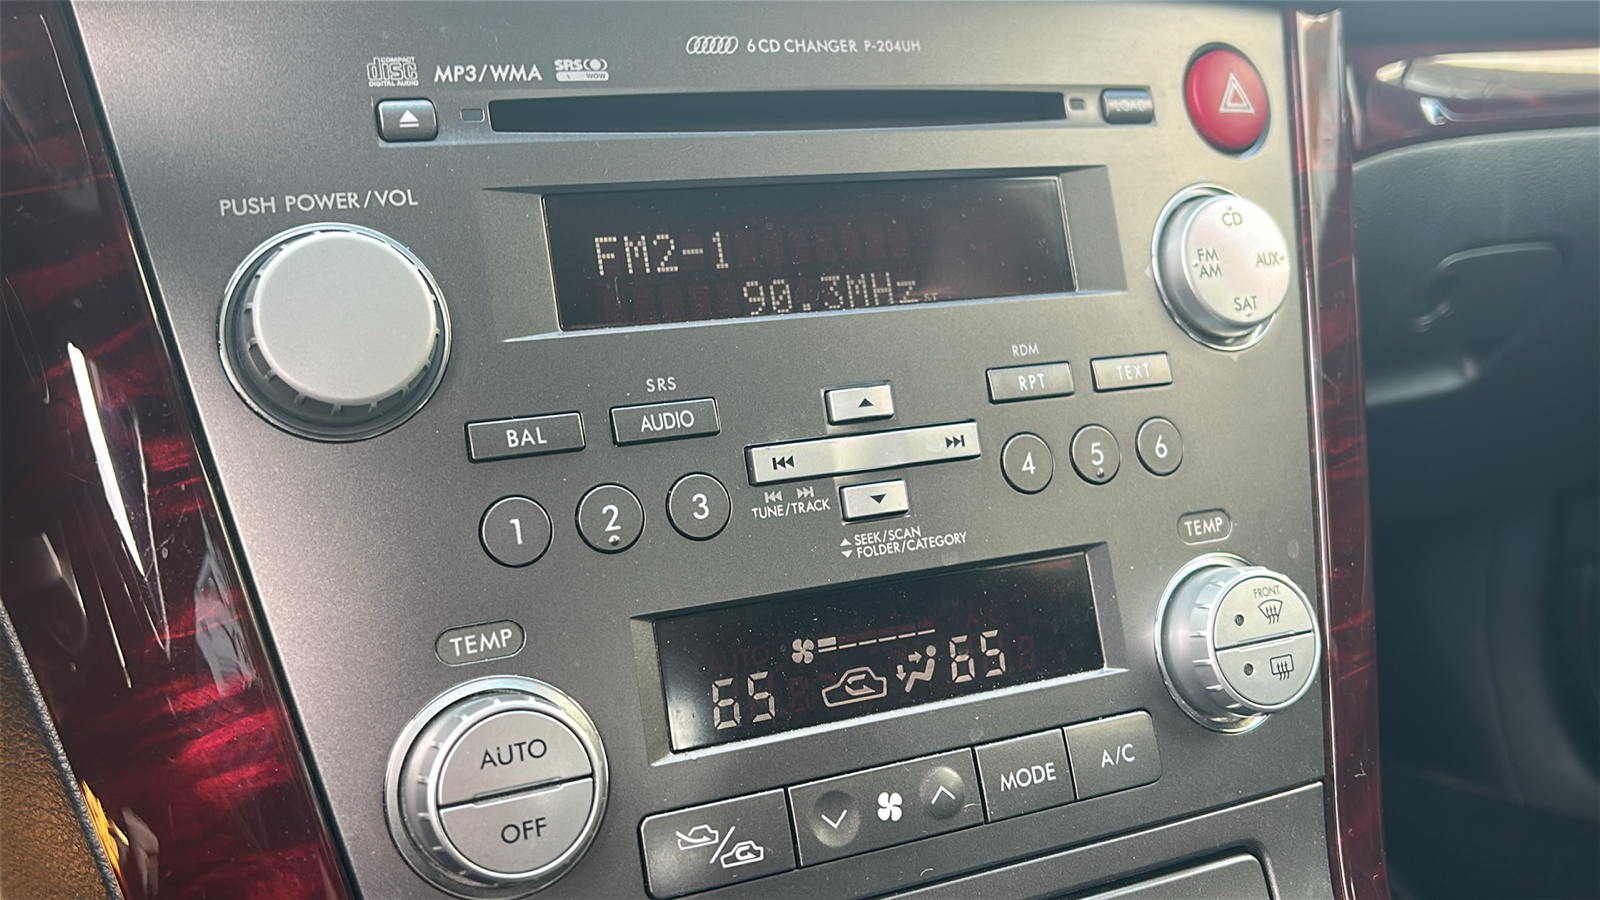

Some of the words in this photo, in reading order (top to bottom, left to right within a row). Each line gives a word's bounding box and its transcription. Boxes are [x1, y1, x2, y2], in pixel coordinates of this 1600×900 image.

[747, 39, 756, 52] 6
[758, 39, 780, 52] CD
[784, 39, 858, 53] CHANGER
[864, 40, 920, 52] P-204UH
[380, 56, 415, 64] COMPACT
[554, 58, 583, 71] SRS
[368, 80, 396, 88] DIGITAL
[434, 64, 543, 83] MP3/WMA
[1115, 99, 1147, 112] LOAD
[219, 196, 276, 216] PUSH
[1221, 212, 1243, 226] CD
[594, 230, 729, 276] FM2-1
[1197, 248, 1219, 262] FM
[1199, 263, 1223, 278] AM
[743, 272, 919, 316] 90.3MHz
[1233, 296, 1258, 311] SAT
[1011, 343, 1039, 357] RDM
[1018, 373, 1045, 391] RPT
[1116, 363, 1151, 381] TEXT
[646, 376, 677, 393] SRS
[640, 409, 695, 432] AUDIO
[506, 427, 547, 448] BAL
[1155, 434, 1168, 459] 6
[1022, 451, 1036, 475] 4
[1090, 442, 1104, 466] 5
[692, 493, 709, 520] 3
[751, 498, 831, 520] TUNE/TRACK
[602, 504, 621, 532] 2
[1184, 516, 1223, 537] TEMP
[509, 518, 523, 545] 1
[854, 526, 922, 547] SEEK/SCAN
[856, 531, 967, 559] FOLDER/CATEGORY
[1253, 585, 1281, 599] FRONT
[449, 628, 513, 656] TEMP
[948, 629, 1006, 684] 65
[711, 671, 776, 730] 65
[479, 738, 548, 770] AUTO
[1101, 743, 1136, 768] A/C
[1000, 762, 1057, 792] MODE
[501, 817, 548, 844] OFF
